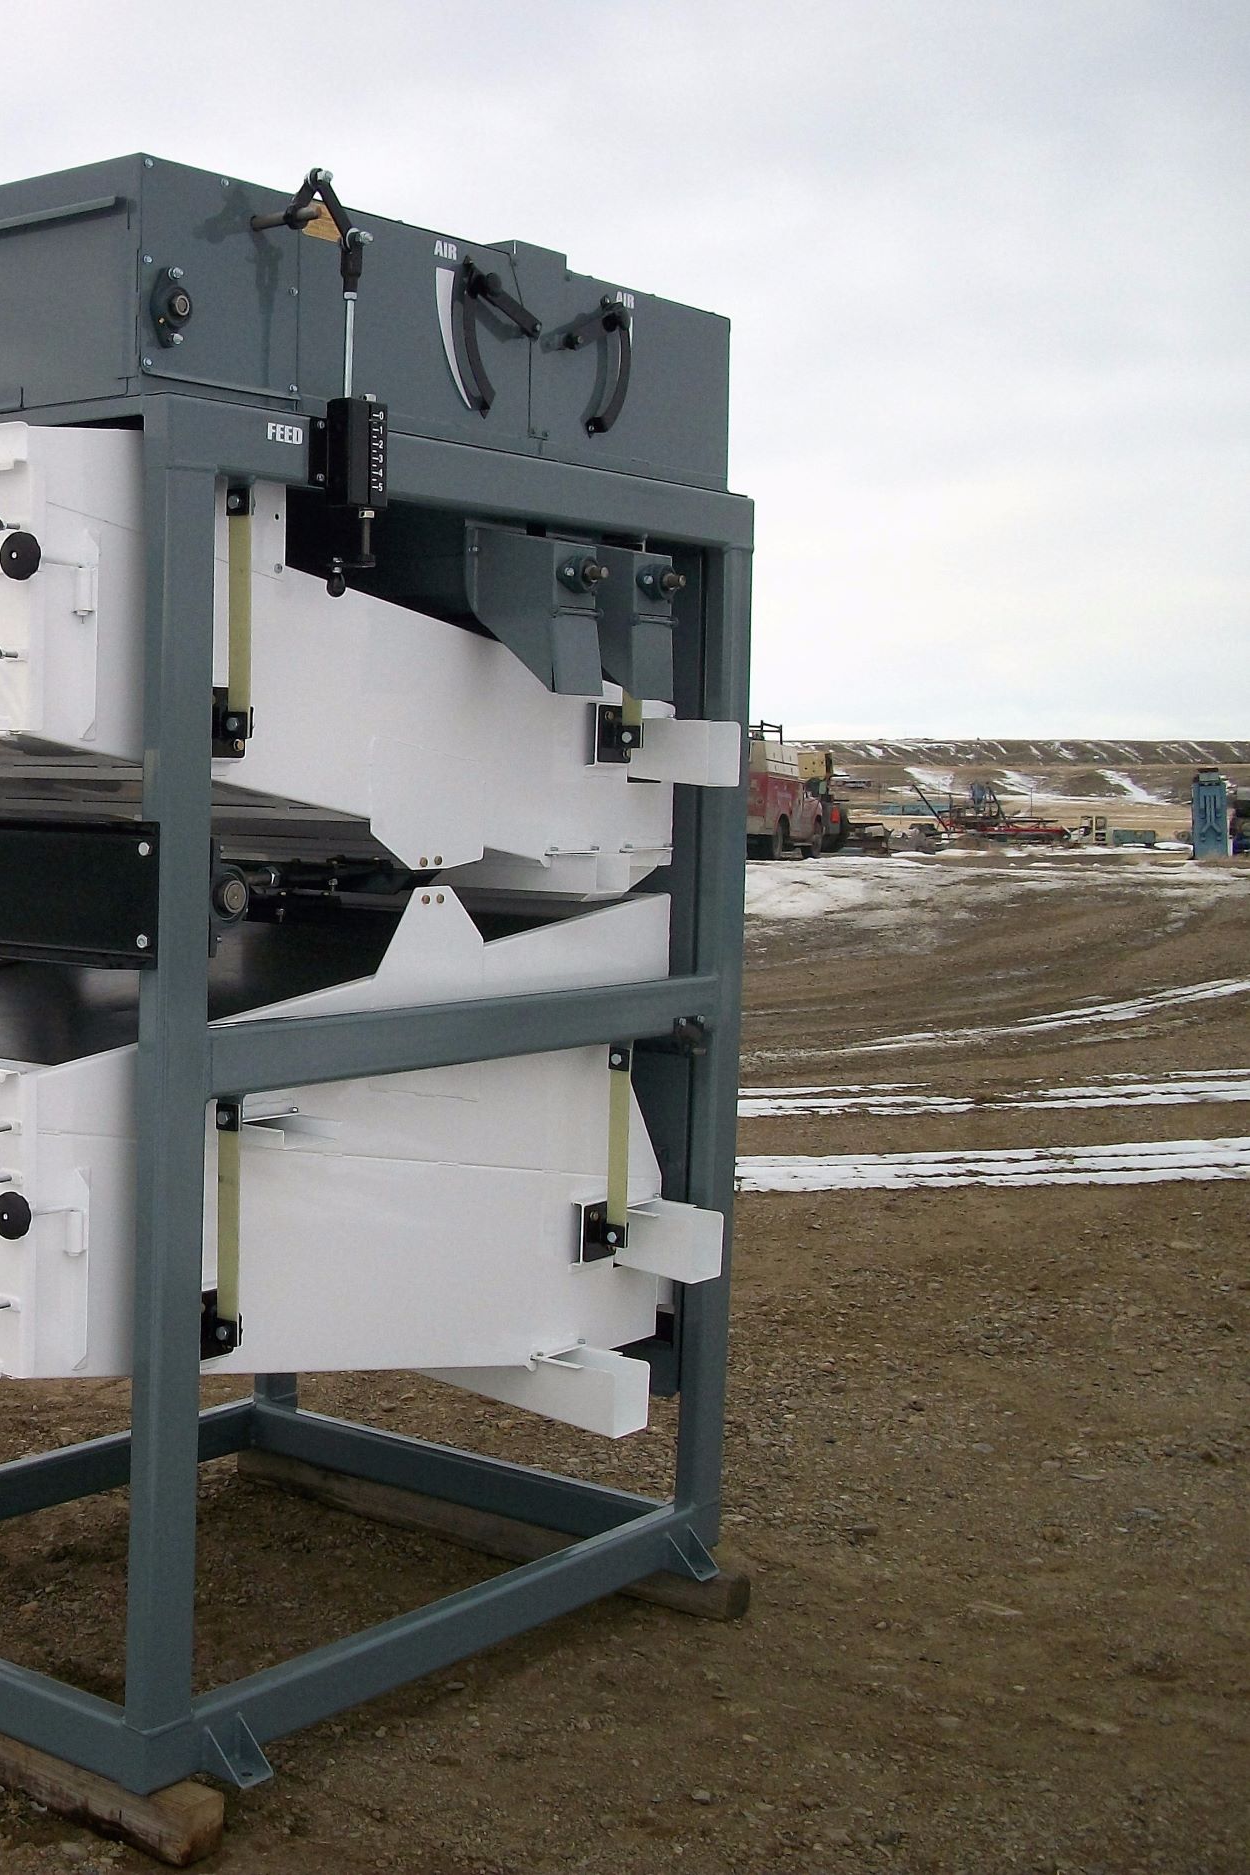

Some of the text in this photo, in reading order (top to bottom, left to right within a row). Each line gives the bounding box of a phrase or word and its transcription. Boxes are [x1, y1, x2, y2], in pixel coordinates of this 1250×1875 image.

[434, 240, 457, 260] AIR
[615, 291, 634, 309] AIR
[379, 411, 384, 420] 0
[267, 422, 303, 445] FEED
[378, 440, 383, 449] 2
[378, 454, 384, 463] 3
[378, 468, 383, 478] 4
[378, 483, 383, 492] 5
